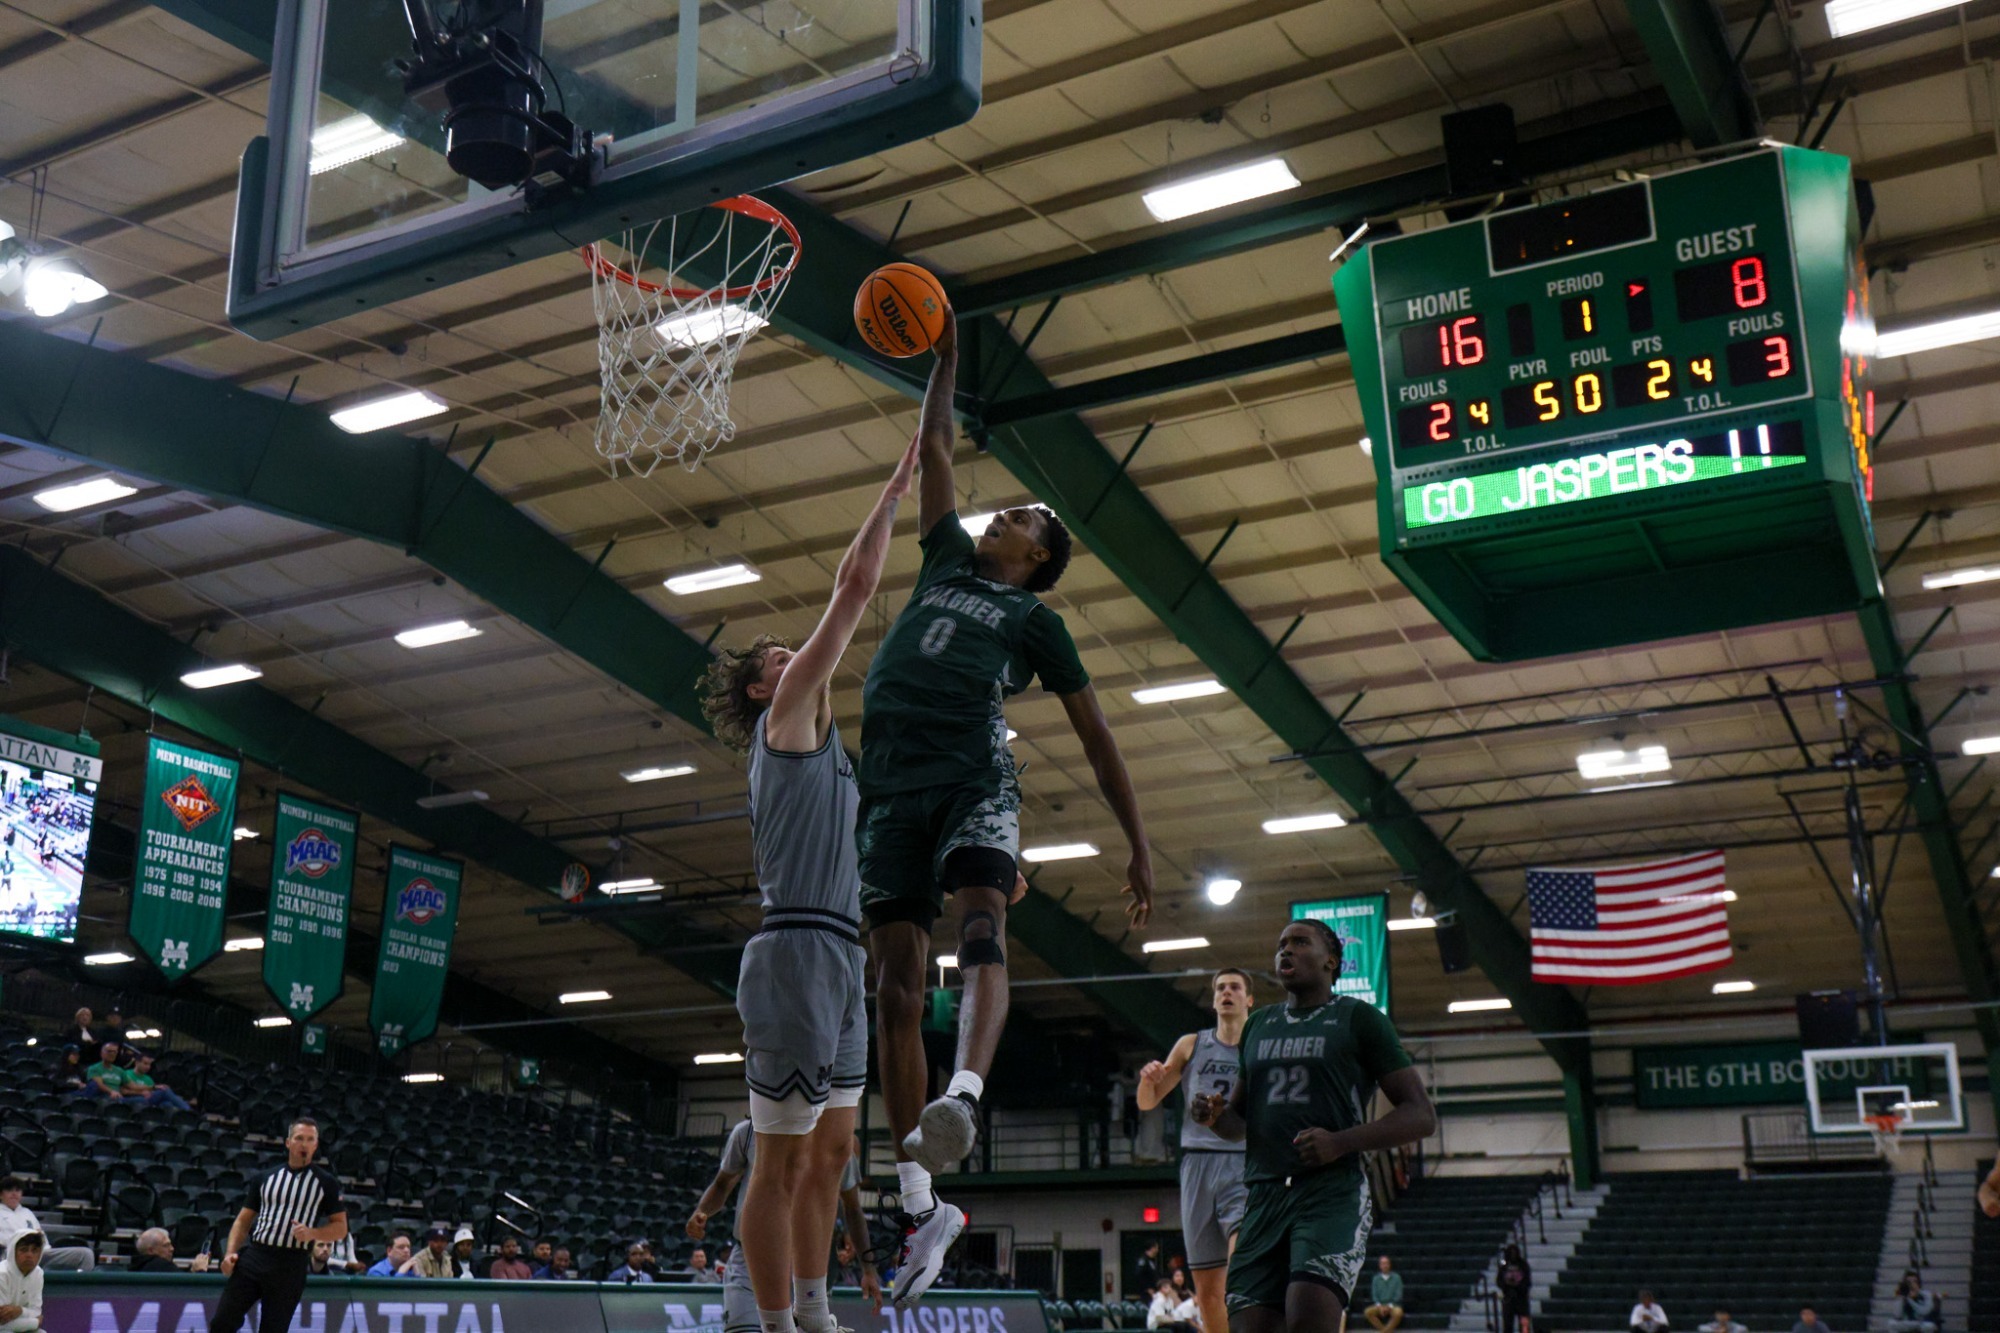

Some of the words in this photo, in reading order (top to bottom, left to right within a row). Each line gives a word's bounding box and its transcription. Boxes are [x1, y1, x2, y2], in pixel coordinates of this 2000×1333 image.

[1676, 224, 1758, 263] GUEST
[1546, 272, 1604, 299] PERIOD
[1732, 256, 1767, 308] 8
[1407, 287, 1473, 321] HOME
[1580, 300, 1593, 333] 1
[1728, 311, 1785, 338] FOULS
[1439, 316, 1484, 366] 16
[1632, 335, 1663, 356] PTS
[1509, 358, 1548, 381] PLYR
[1570, 346, 1612, 369] FOUL
[1691, 358, 1712, 383] 4
[1764, 336, 1791, 378] 3
[1399, 378, 1448, 402] FOULS
[1647, 359, 1672, 401] 2
[1469, 401, 1490, 425] 4
[1684, 396, 1732, 415] T.O.L.
[1429, 402, 1451, 441] 2
[1462, 436, 1506, 454] T.O.L.
[1421, 479, 1475, 523] GO
[1501, 438, 1696, 511] JASPERS
[919, 586, 1007, 631] WAGNER
[919, 616, 957, 656] 0
[156, 748, 182, 766] MEN'S
[183, 756, 232, 779] BASKETBALL
[176, 794, 208, 812] NIT
[146, 829, 226, 860] TOURNAMENT
[286, 839, 341, 873] MAAC
[144, 845, 224, 876] APPEARANCES
[142, 882, 166, 898] 1996
[170, 888, 194, 904] 2002
[144, 865, 167, 881] 1975
[172, 871, 195, 887] 1992
[200, 878, 222, 892] 1994
[277, 879, 346, 907] TOURNAMENT
[276, 893, 344, 923] CHAMPIONS
[396, 888, 446, 919] MAAC
[387, 941, 446, 967] CHAMPIONS
[1257, 1036, 1327, 1060] WAGNER
[1266, 1066, 1312, 1105] 22
[1646, 1065, 1700, 1090] THE
[1705, 1061, 1763, 1088] 6TH
